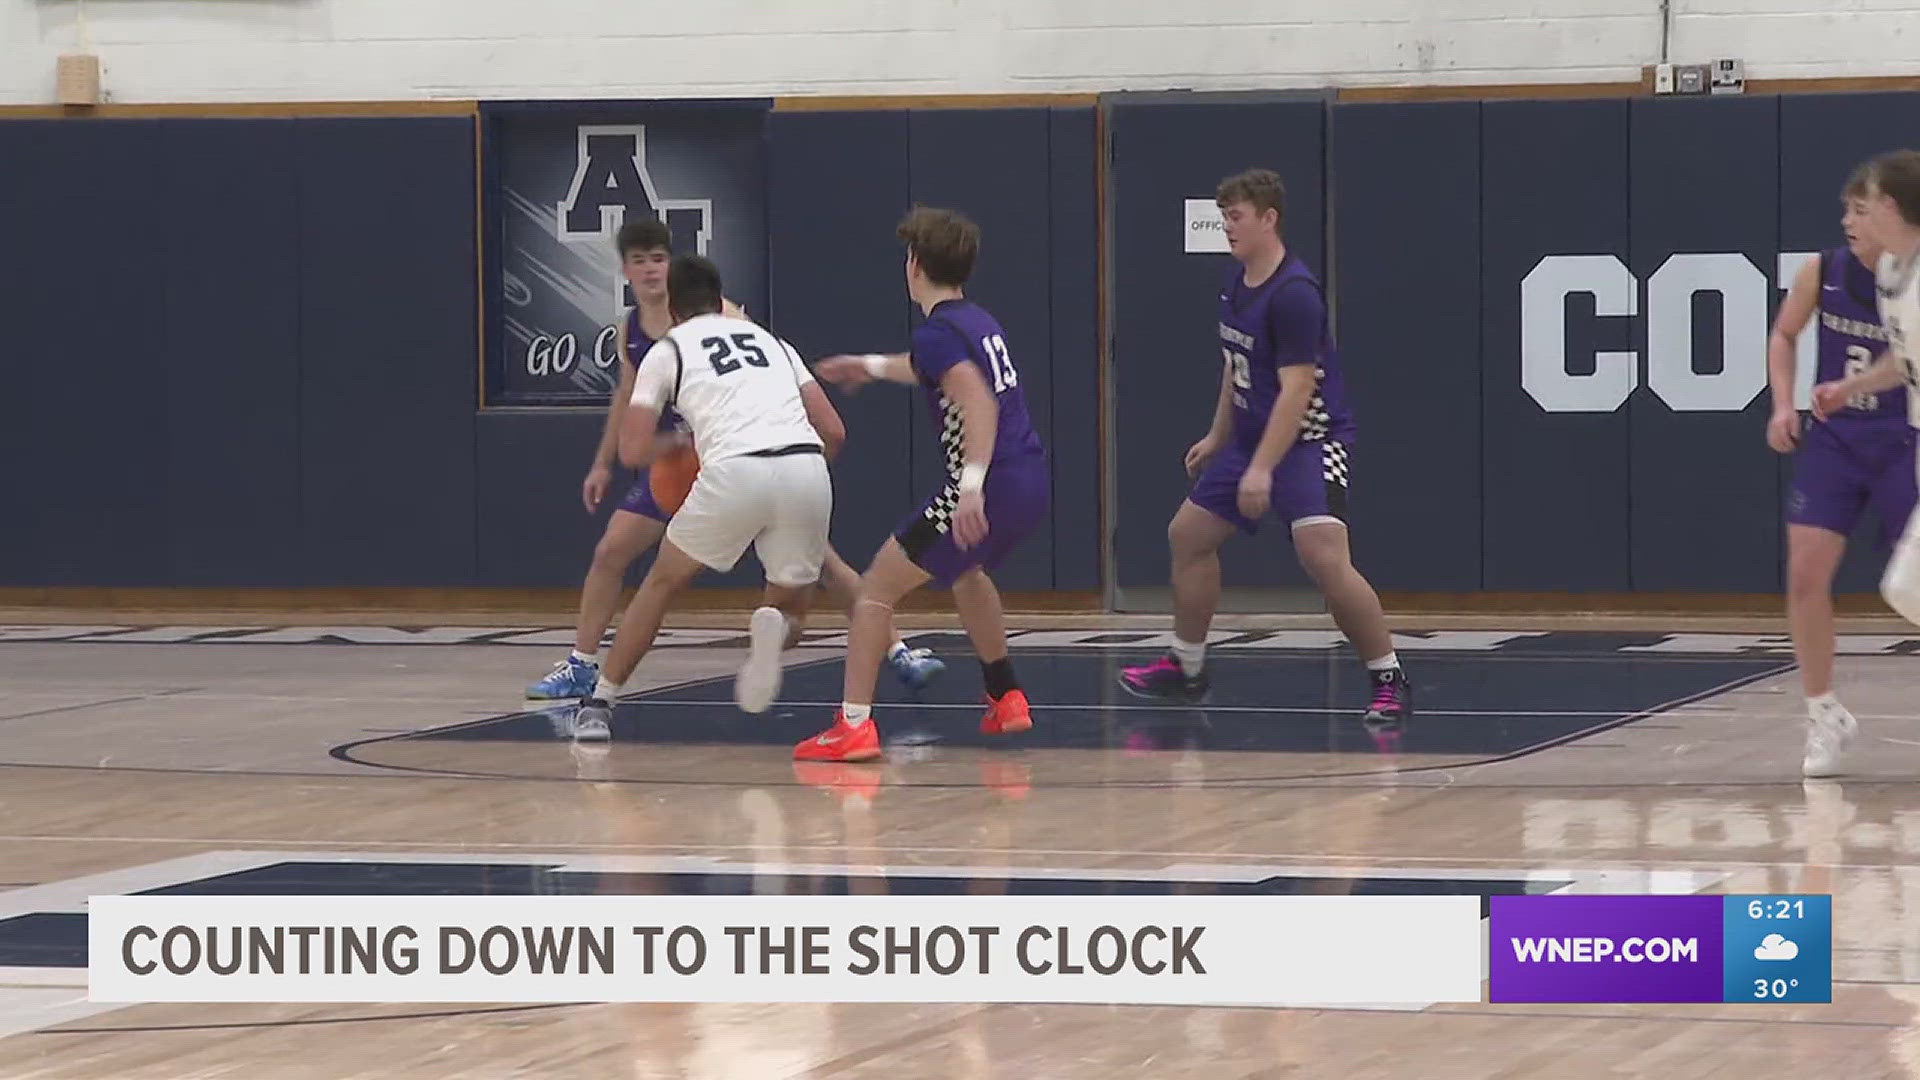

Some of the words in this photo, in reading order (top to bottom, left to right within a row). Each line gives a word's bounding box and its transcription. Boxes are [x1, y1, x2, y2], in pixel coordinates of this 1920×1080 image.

[1191, 220, 1225, 231] OFFIC
[527, 333, 576, 376] GO
[594, 325, 625, 368] C
[701, 333, 769, 376] 25
[981, 334, 1018, 393] 13
